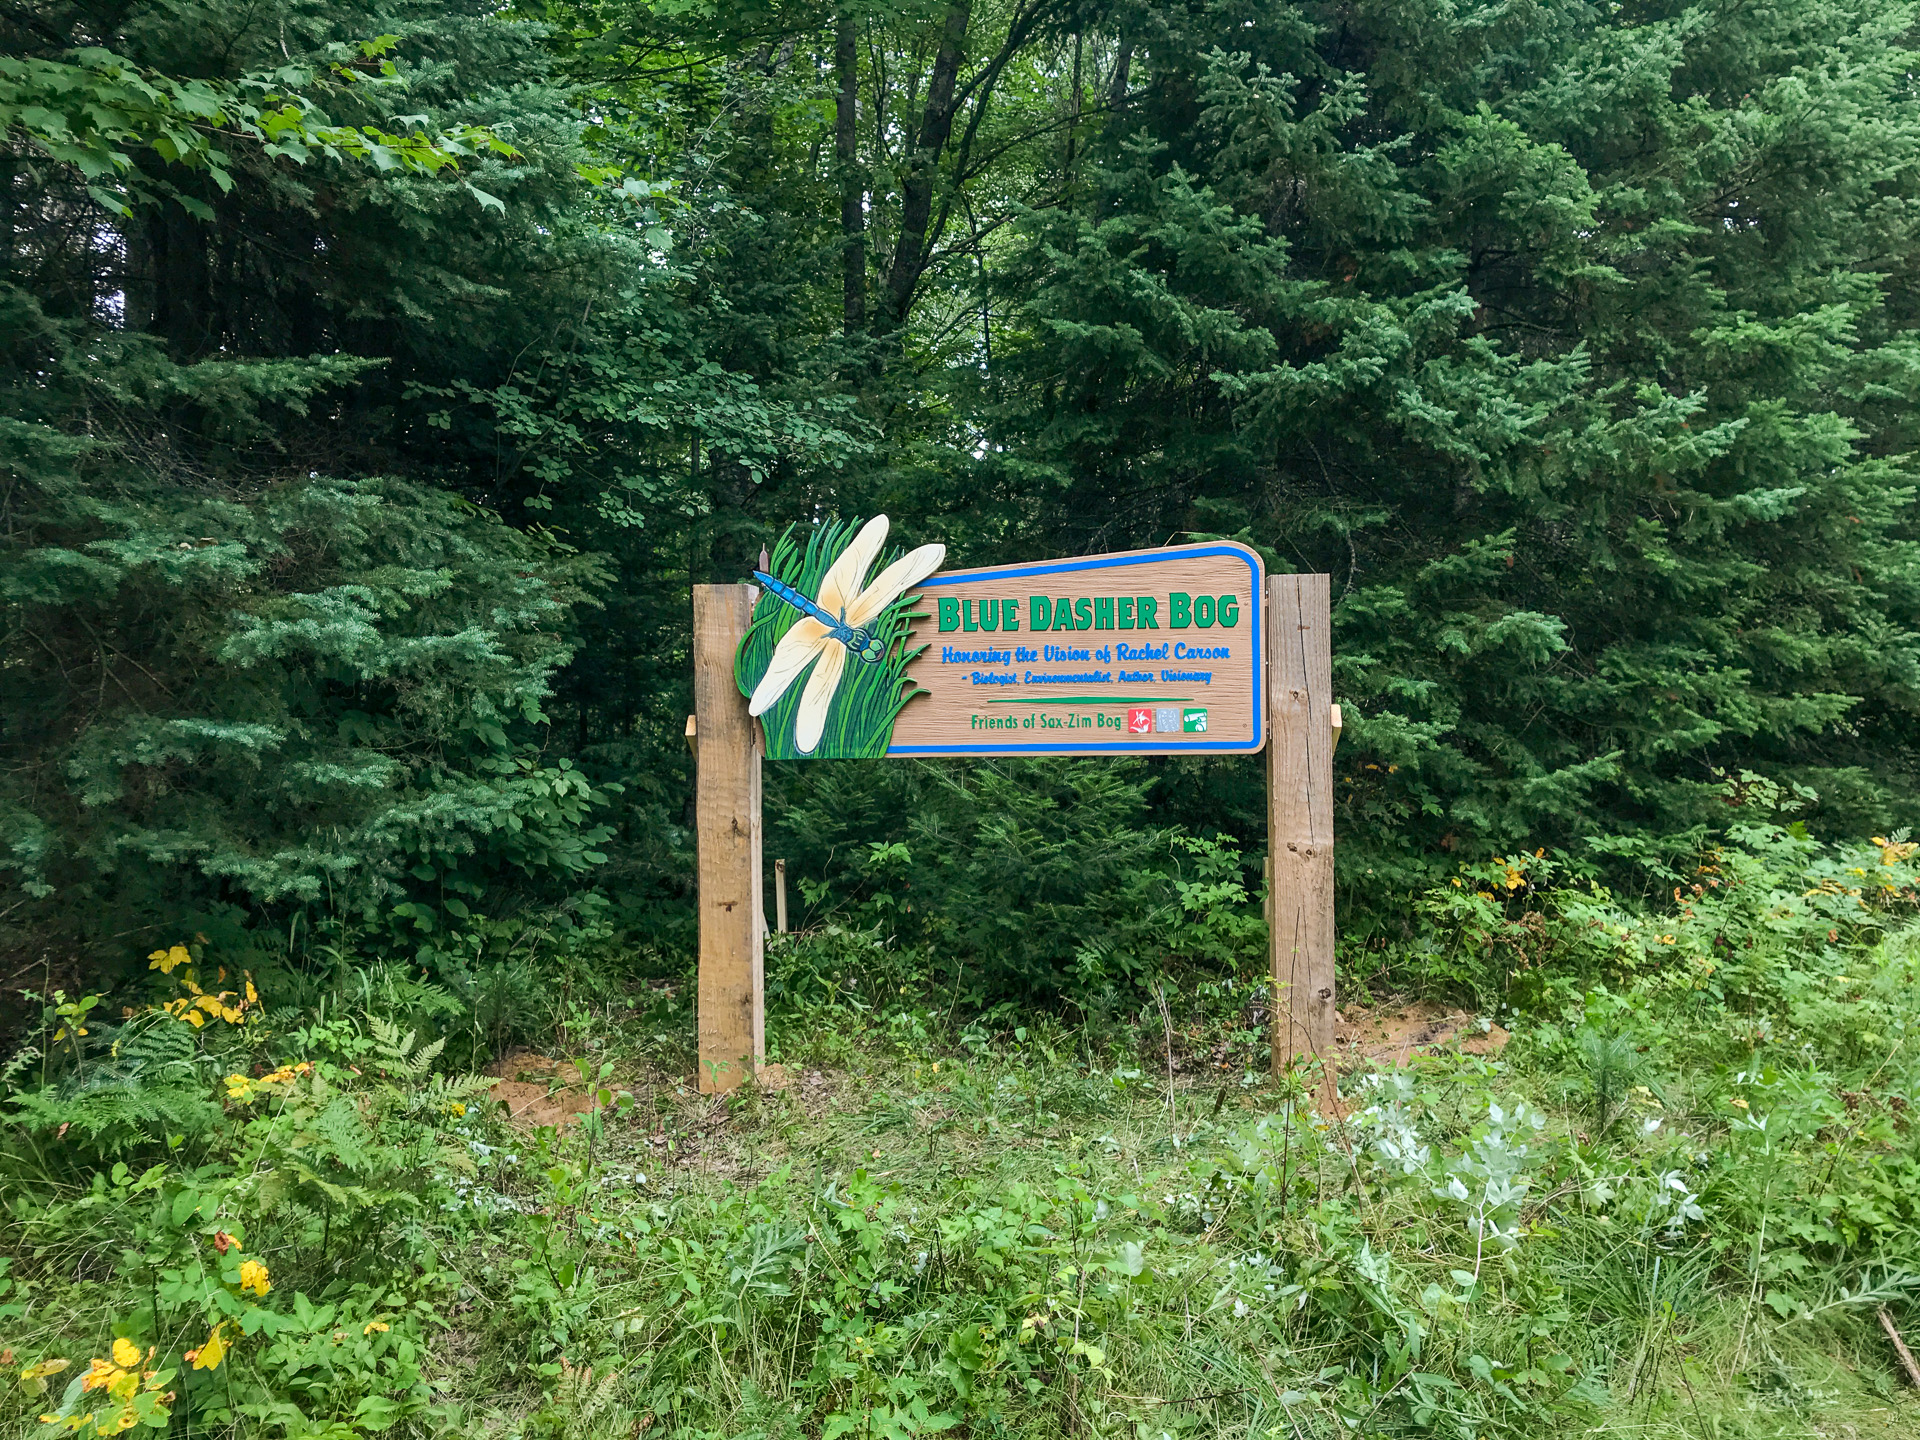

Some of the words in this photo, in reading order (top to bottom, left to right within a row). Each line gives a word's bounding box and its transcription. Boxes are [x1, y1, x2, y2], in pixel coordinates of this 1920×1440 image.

[937, 596, 1020, 633] BLUE
[1030, 595, 1160, 631] DASHER
[1169, 592, 1240, 628] BOG
[941, 646, 1011, 666] Honoring
[1015, 645, 1038, 662] the
[1044, 644, 1090, 662] Vision
[1095, 645, 1111, 664] of
[1116, 642, 1170, 661] Rachel
[1174, 641, 1231, 660] Carson
[971, 671, 1020, 686] Biologist,
[1161, 669, 1212, 685] Visionary
[971, 714, 1018, 729] Friends
[1023, 714, 1036, 729] of
[1040, 713, 1093, 728] Sax-Zim
[1097, 712, 1122, 731] Bog
